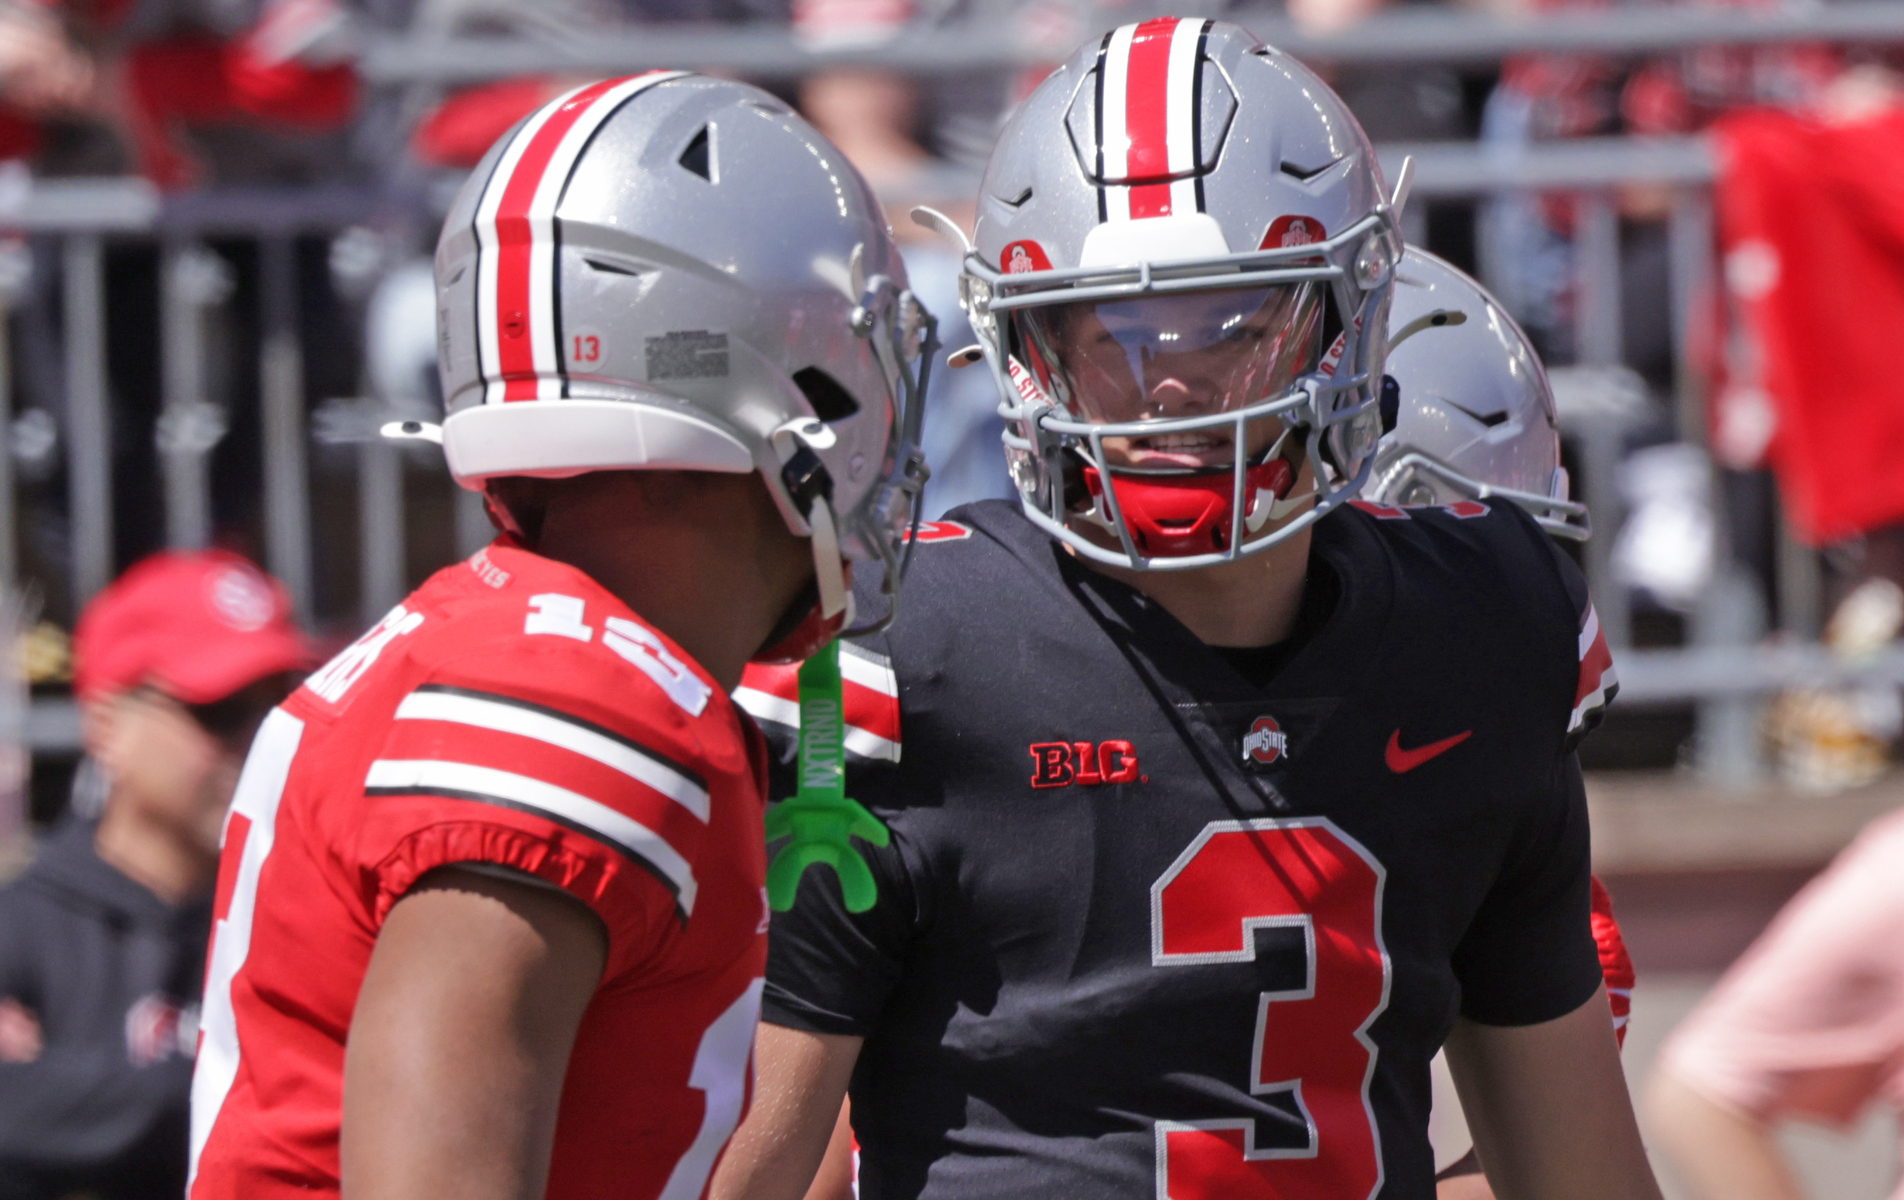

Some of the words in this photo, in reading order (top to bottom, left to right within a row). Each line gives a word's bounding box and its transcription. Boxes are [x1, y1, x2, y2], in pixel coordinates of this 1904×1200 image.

[573, 335, 600, 361] 13
[471, 547, 511, 589] EYES
[802, 698, 839, 788] NXTRND
